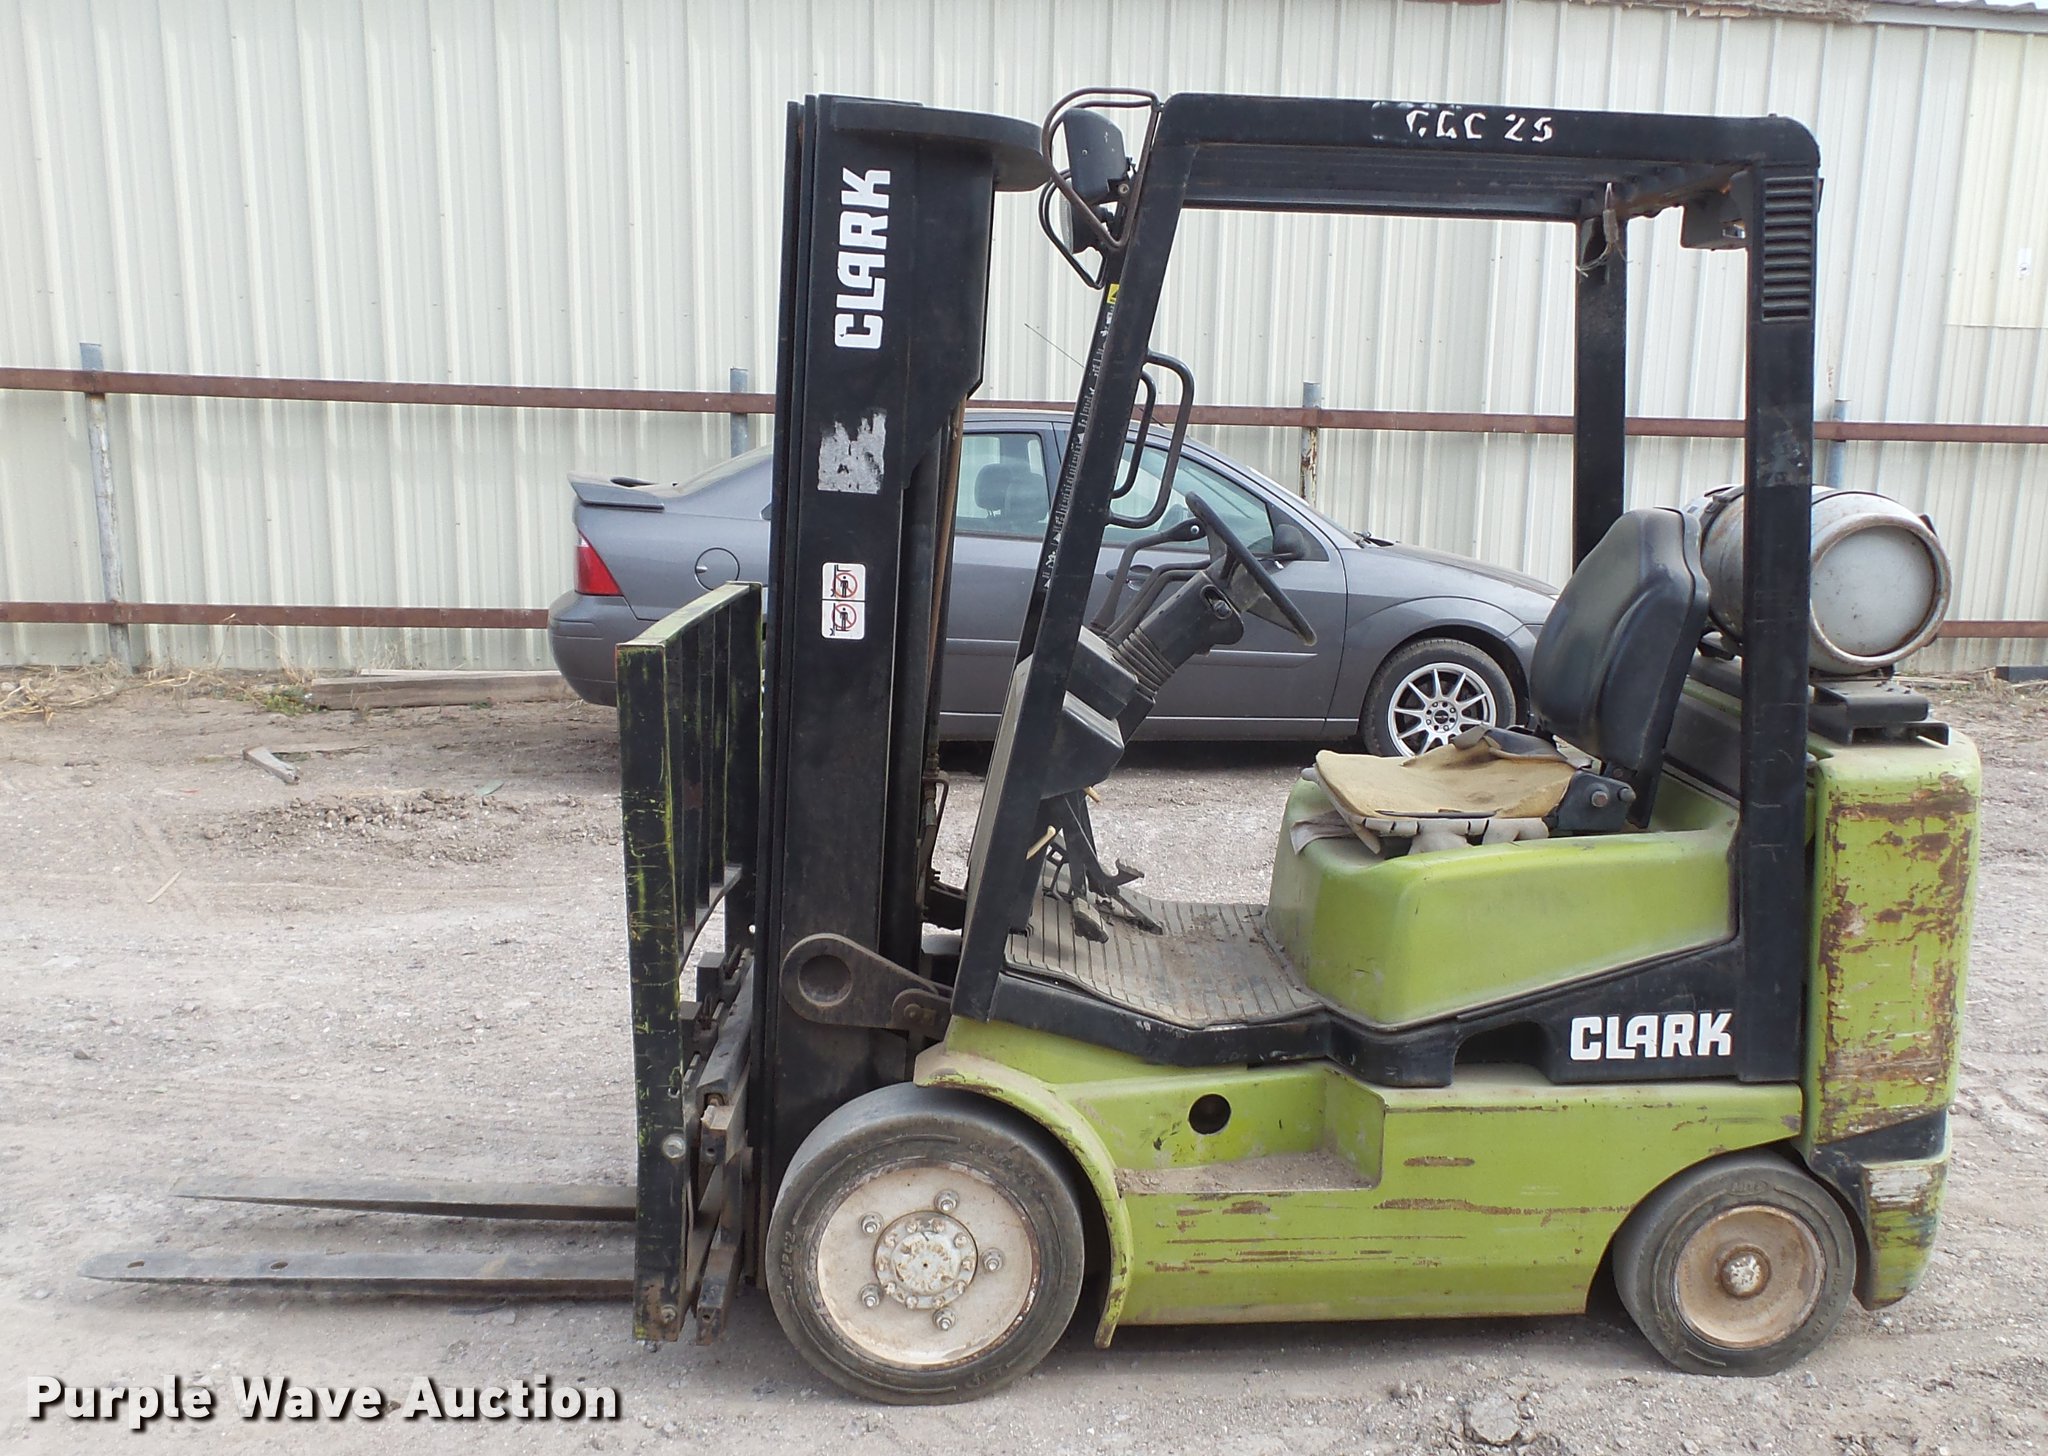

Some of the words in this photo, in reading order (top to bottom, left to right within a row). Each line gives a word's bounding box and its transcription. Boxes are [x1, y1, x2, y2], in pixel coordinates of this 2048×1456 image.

[1503, 112, 1553, 143] 25
[834, 166, 891, 350] CLARK
[1569, 1012, 1733, 1061] CLARK
